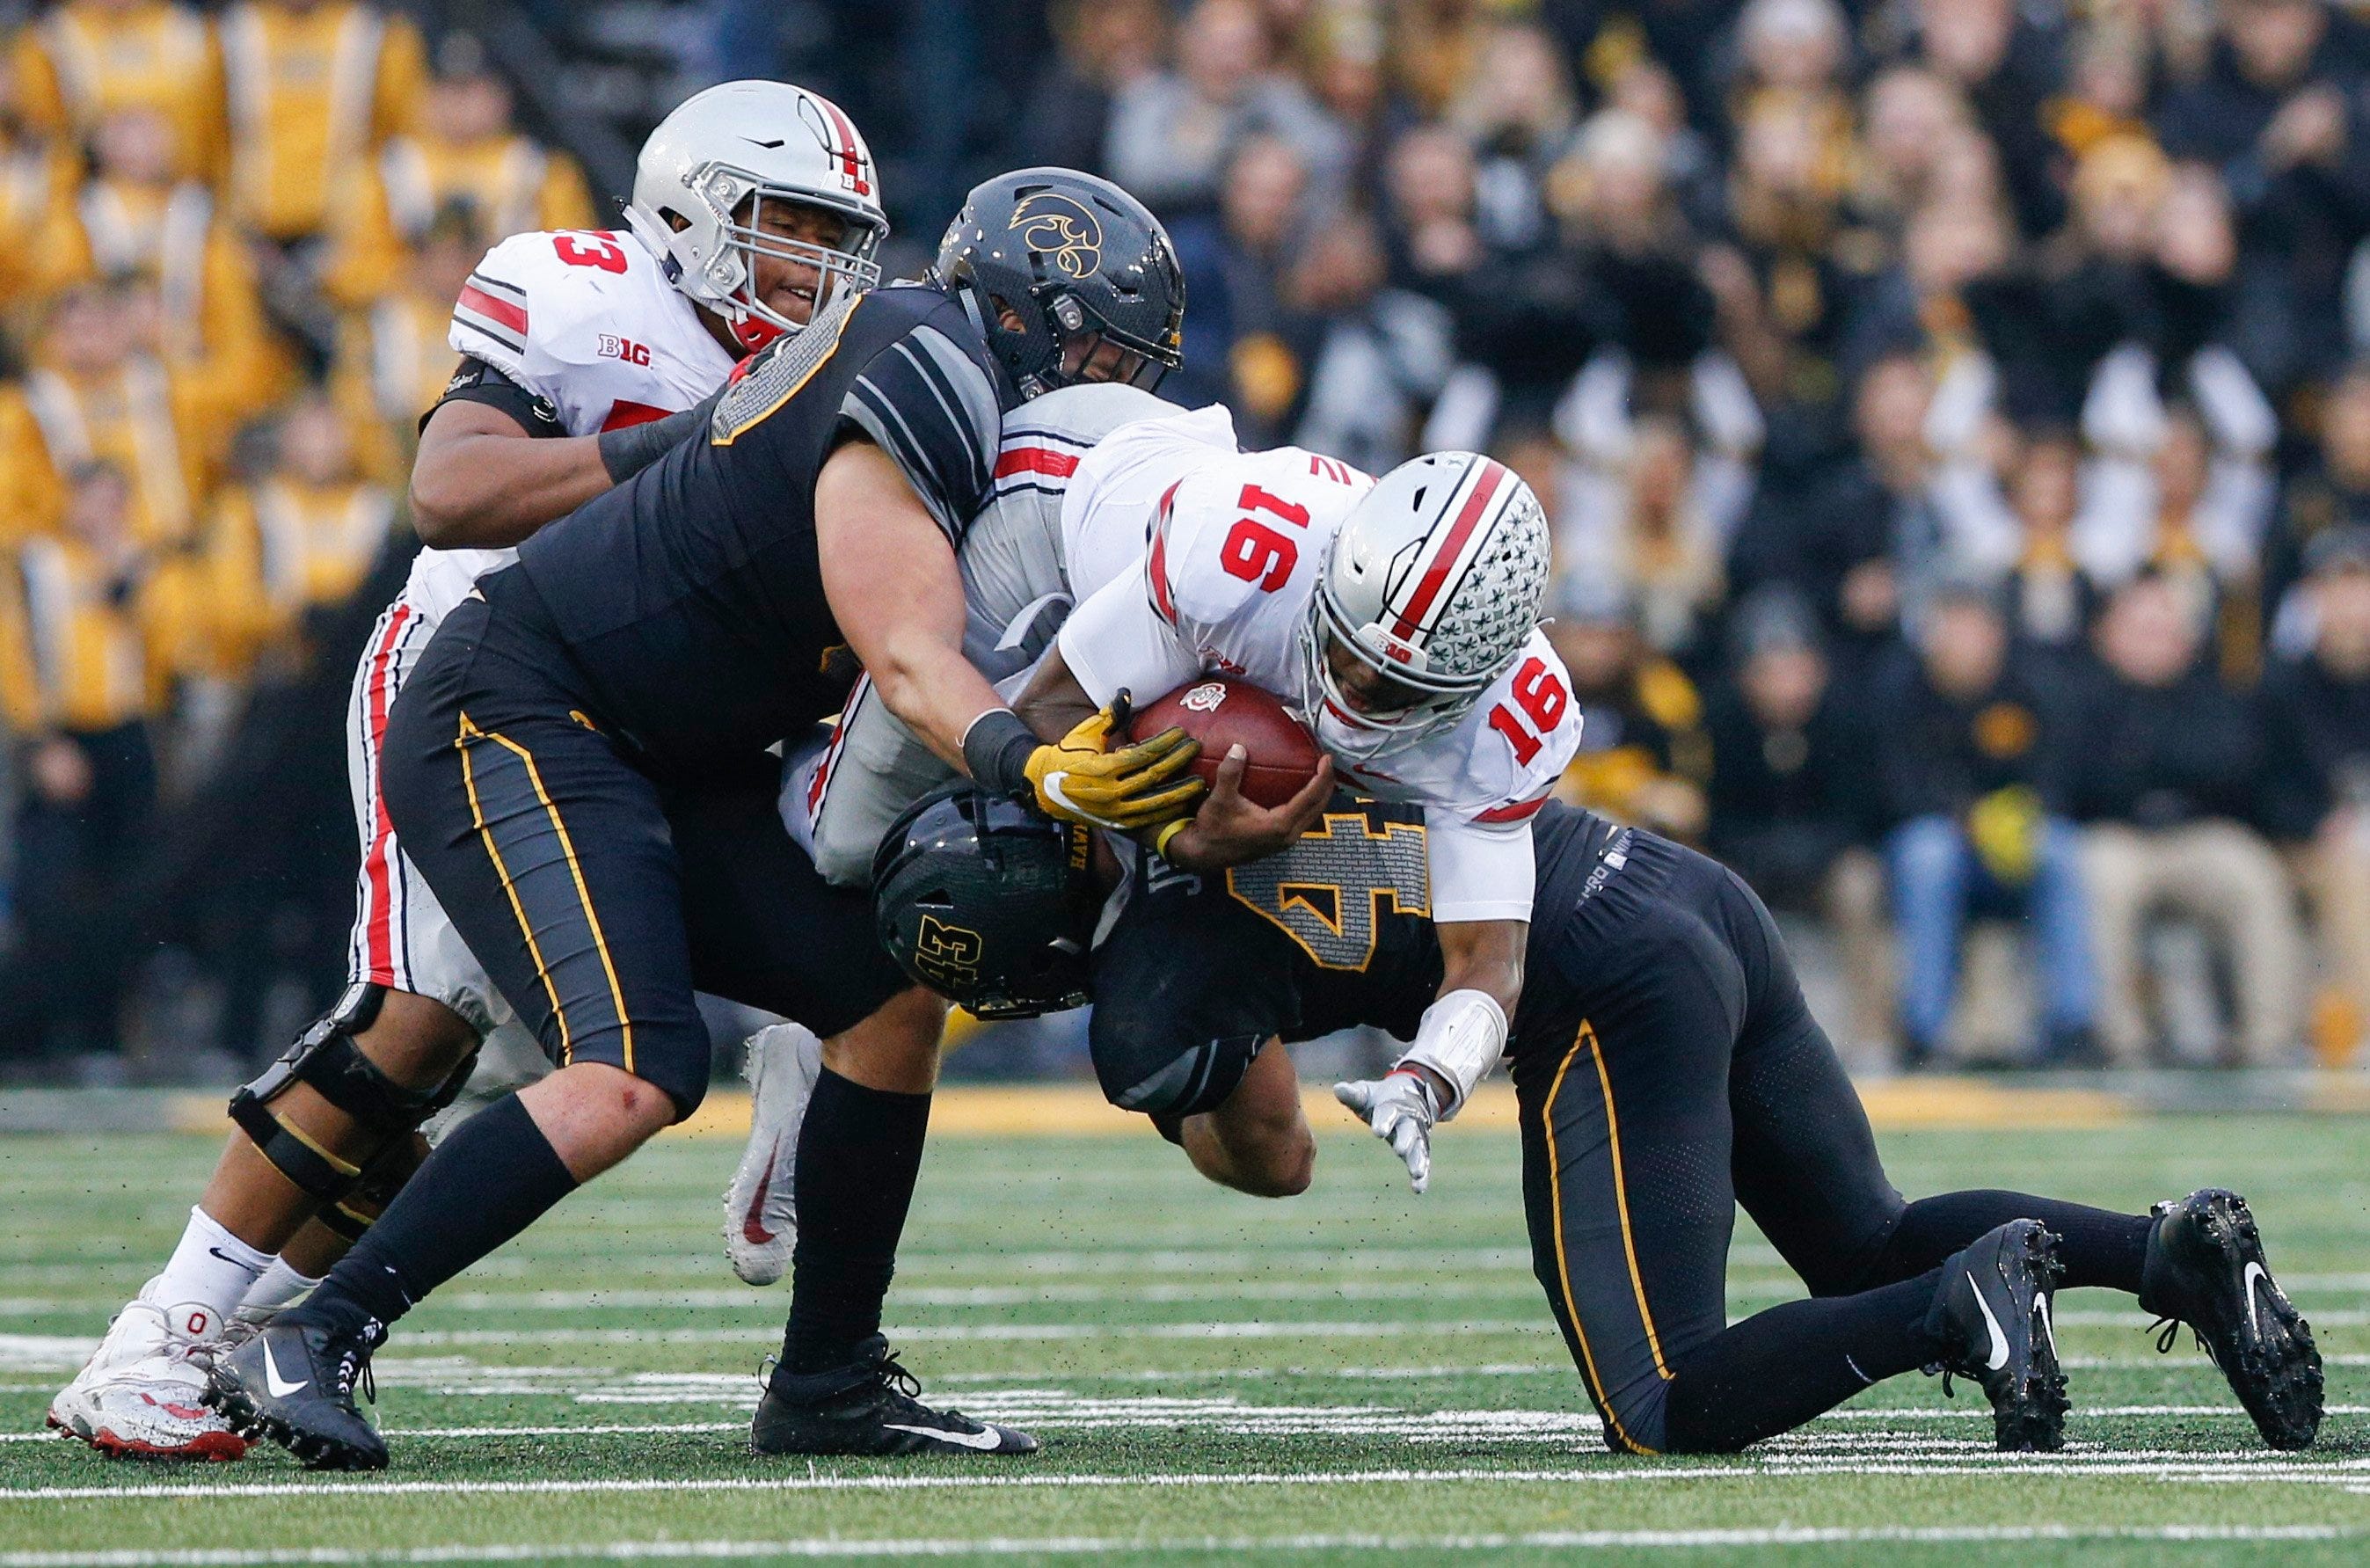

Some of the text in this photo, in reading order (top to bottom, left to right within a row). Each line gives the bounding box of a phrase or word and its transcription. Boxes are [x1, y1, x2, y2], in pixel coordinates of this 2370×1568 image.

[1220, 483, 1311, 594] 16
[1488, 656, 1567, 769] 16
[1225, 797, 1432, 974] 4
[915, 914, 983, 988] 43
